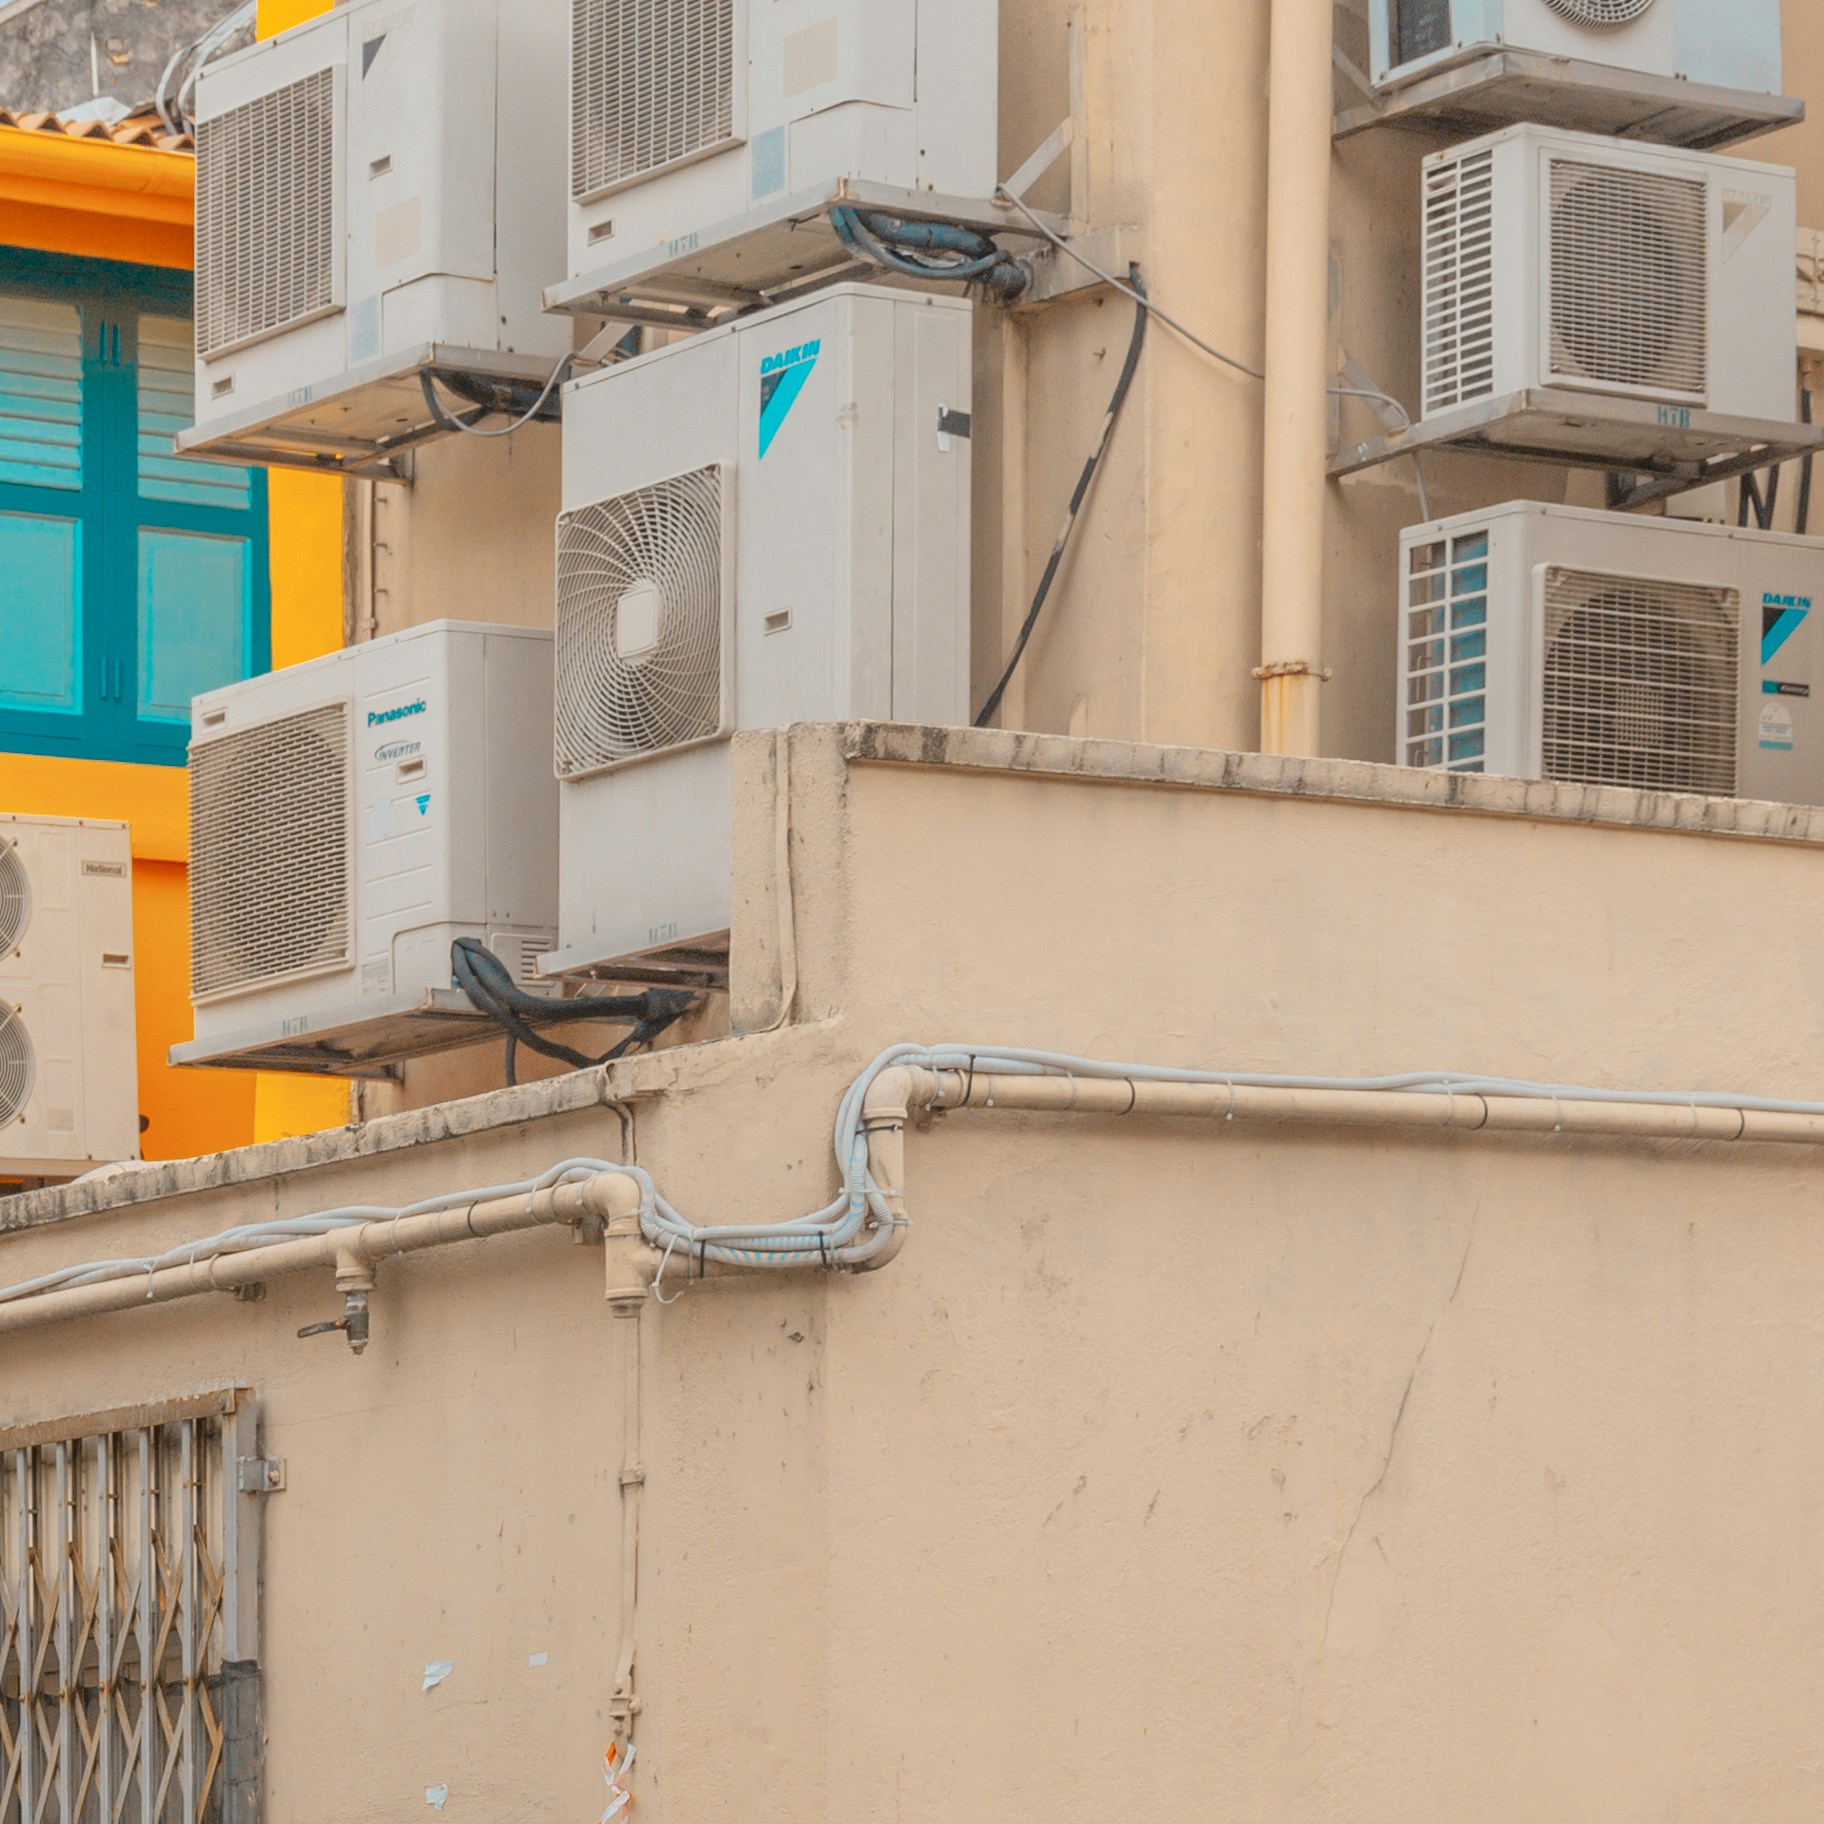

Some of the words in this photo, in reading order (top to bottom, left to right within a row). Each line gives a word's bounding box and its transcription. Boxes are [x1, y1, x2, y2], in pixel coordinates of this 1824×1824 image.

[759, 338, 821, 375] DAIKIN
[1762, 592, 1811, 609] DAIKIN
[367, 697, 427, 728] Panasonic
[378, 741, 422, 762] INVERTER
